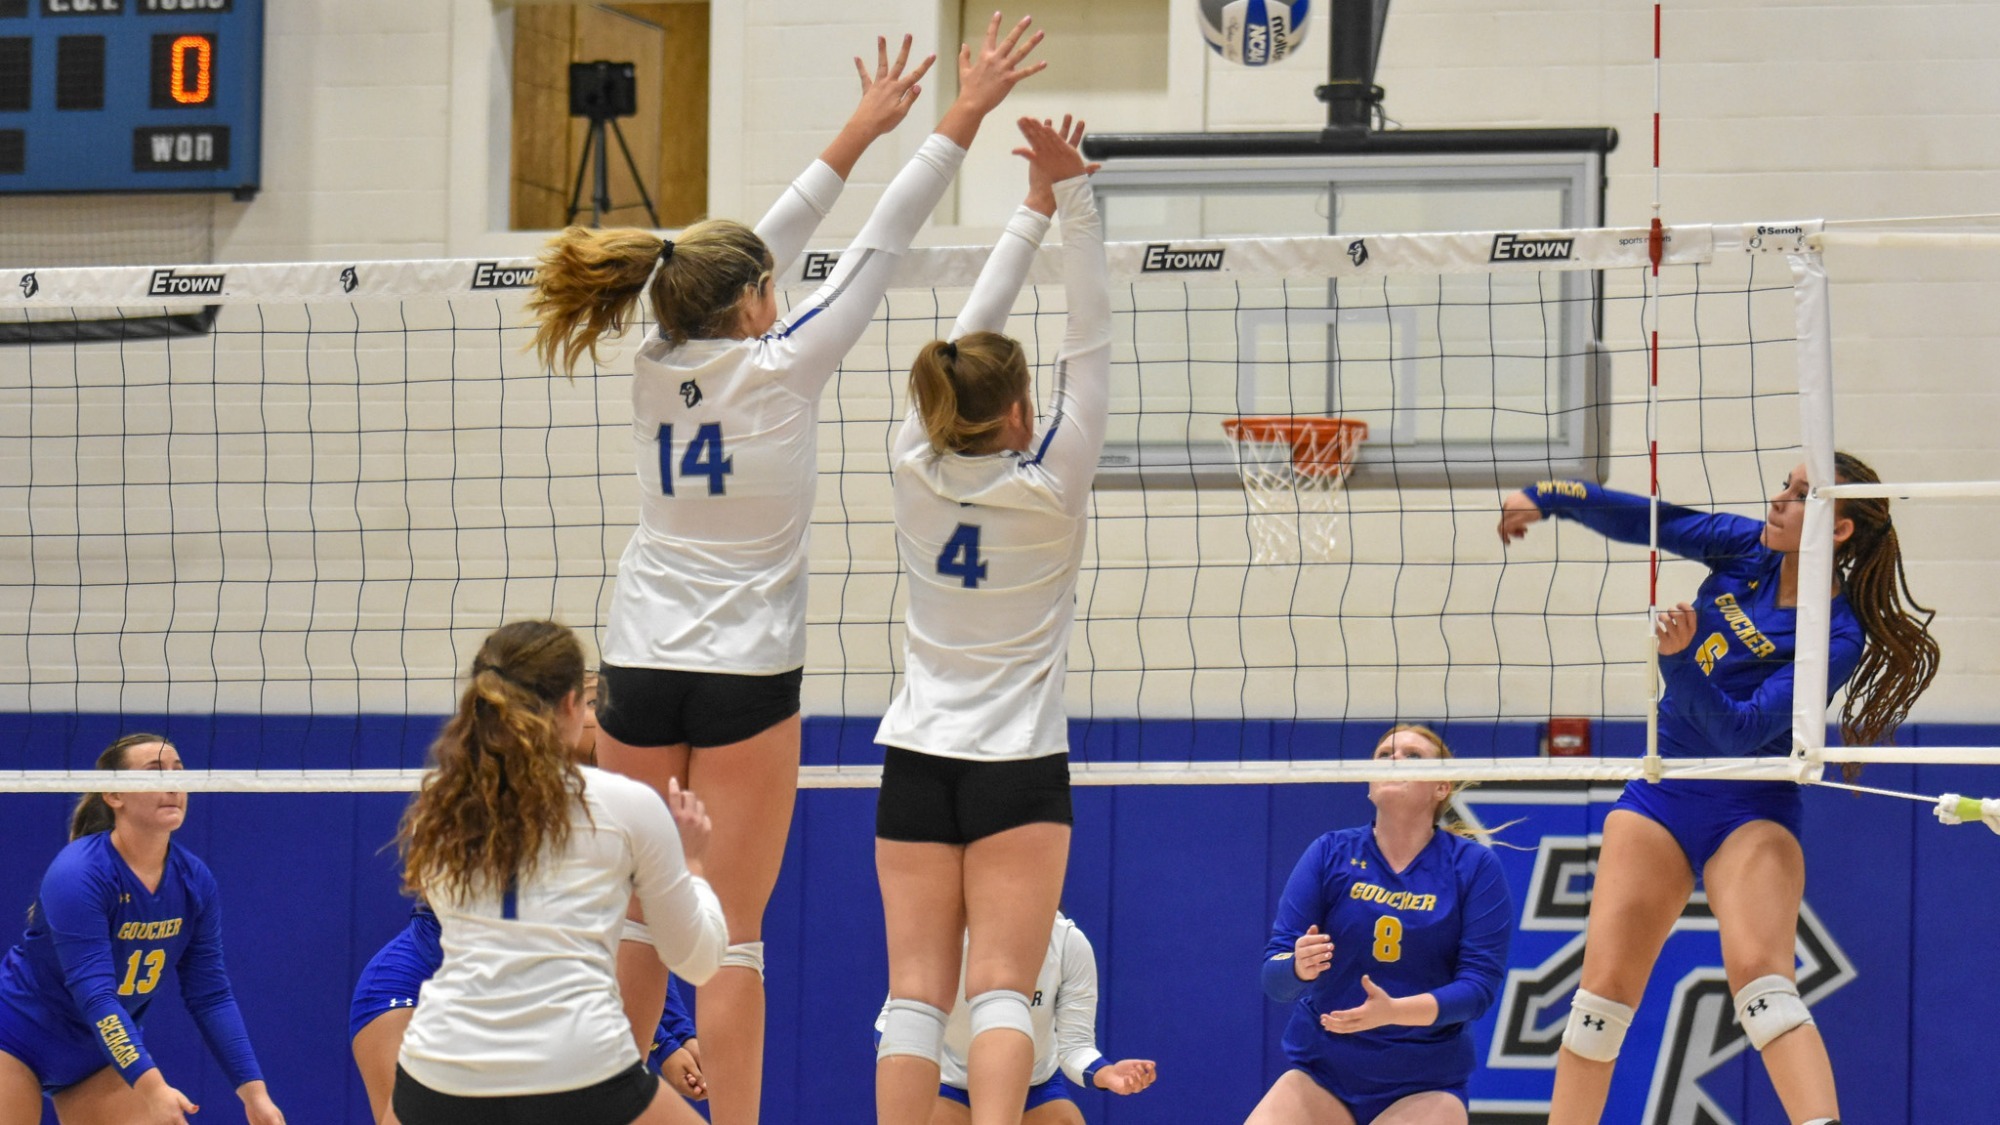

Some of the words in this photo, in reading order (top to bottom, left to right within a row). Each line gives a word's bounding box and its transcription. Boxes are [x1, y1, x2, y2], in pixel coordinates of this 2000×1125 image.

[1247, 23, 1267, 62] NCAA
[171, 36, 211, 103] 0
[151, 132, 214, 163] WON
[1619, 236, 1643, 246] sports
[1767, 225, 1802, 235] Senoh
[474, 264, 540, 286] ETOW
[654, 421, 734, 497] 14
[936, 521, 989, 589] 4
[1714, 592, 1776, 659] GOUCHER
[1350, 881, 1437, 911] GOUCHER
[117, 917, 183, 941] GOUCHER
[1372, 914, 1403, 963] 8
[117, 948, 166, 996] 13
[96, 1013, 141, 1070] GOPHERS
